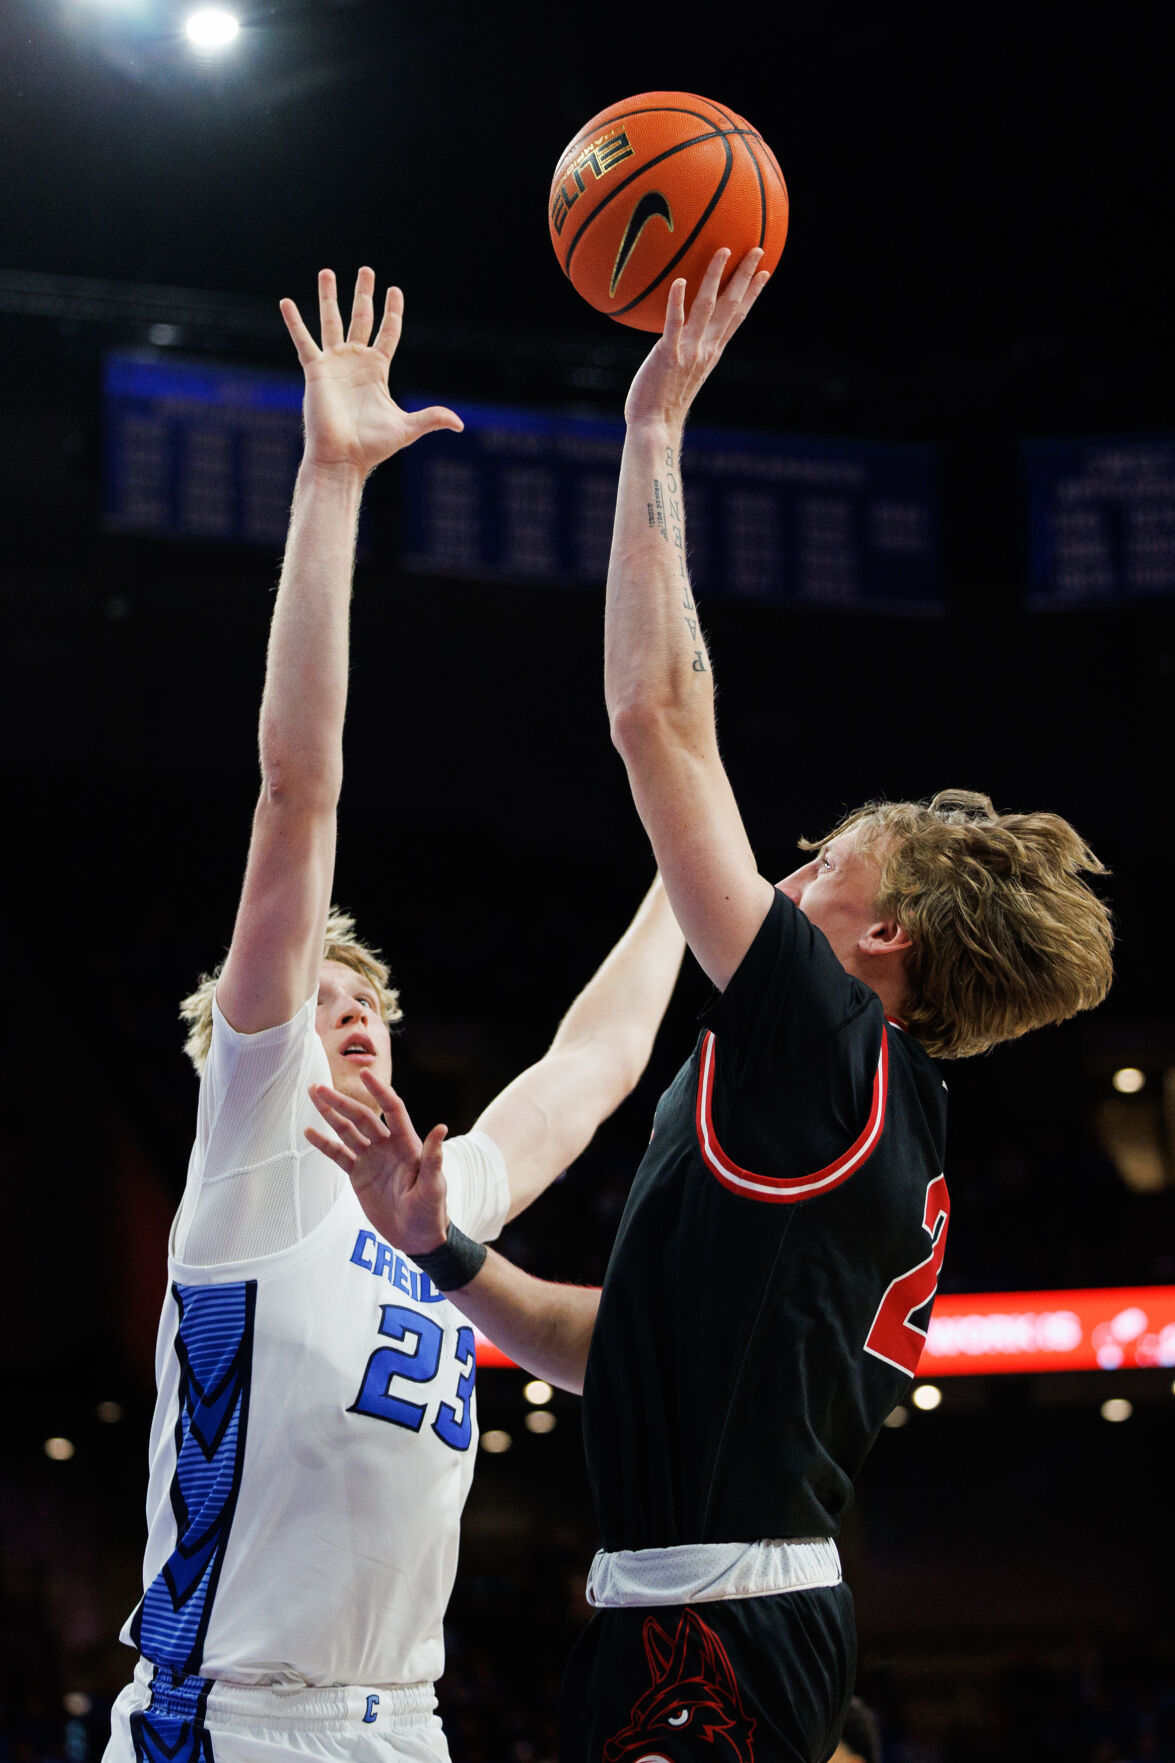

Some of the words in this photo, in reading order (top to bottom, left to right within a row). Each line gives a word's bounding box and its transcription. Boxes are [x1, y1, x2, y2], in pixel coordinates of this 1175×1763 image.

[551, 131, 634, 237] ELITE
[666, 446, 707, 672] PATIENCE
[345, 1304, 476, 1452] 23
[362, 1694, 380, 1724] C
